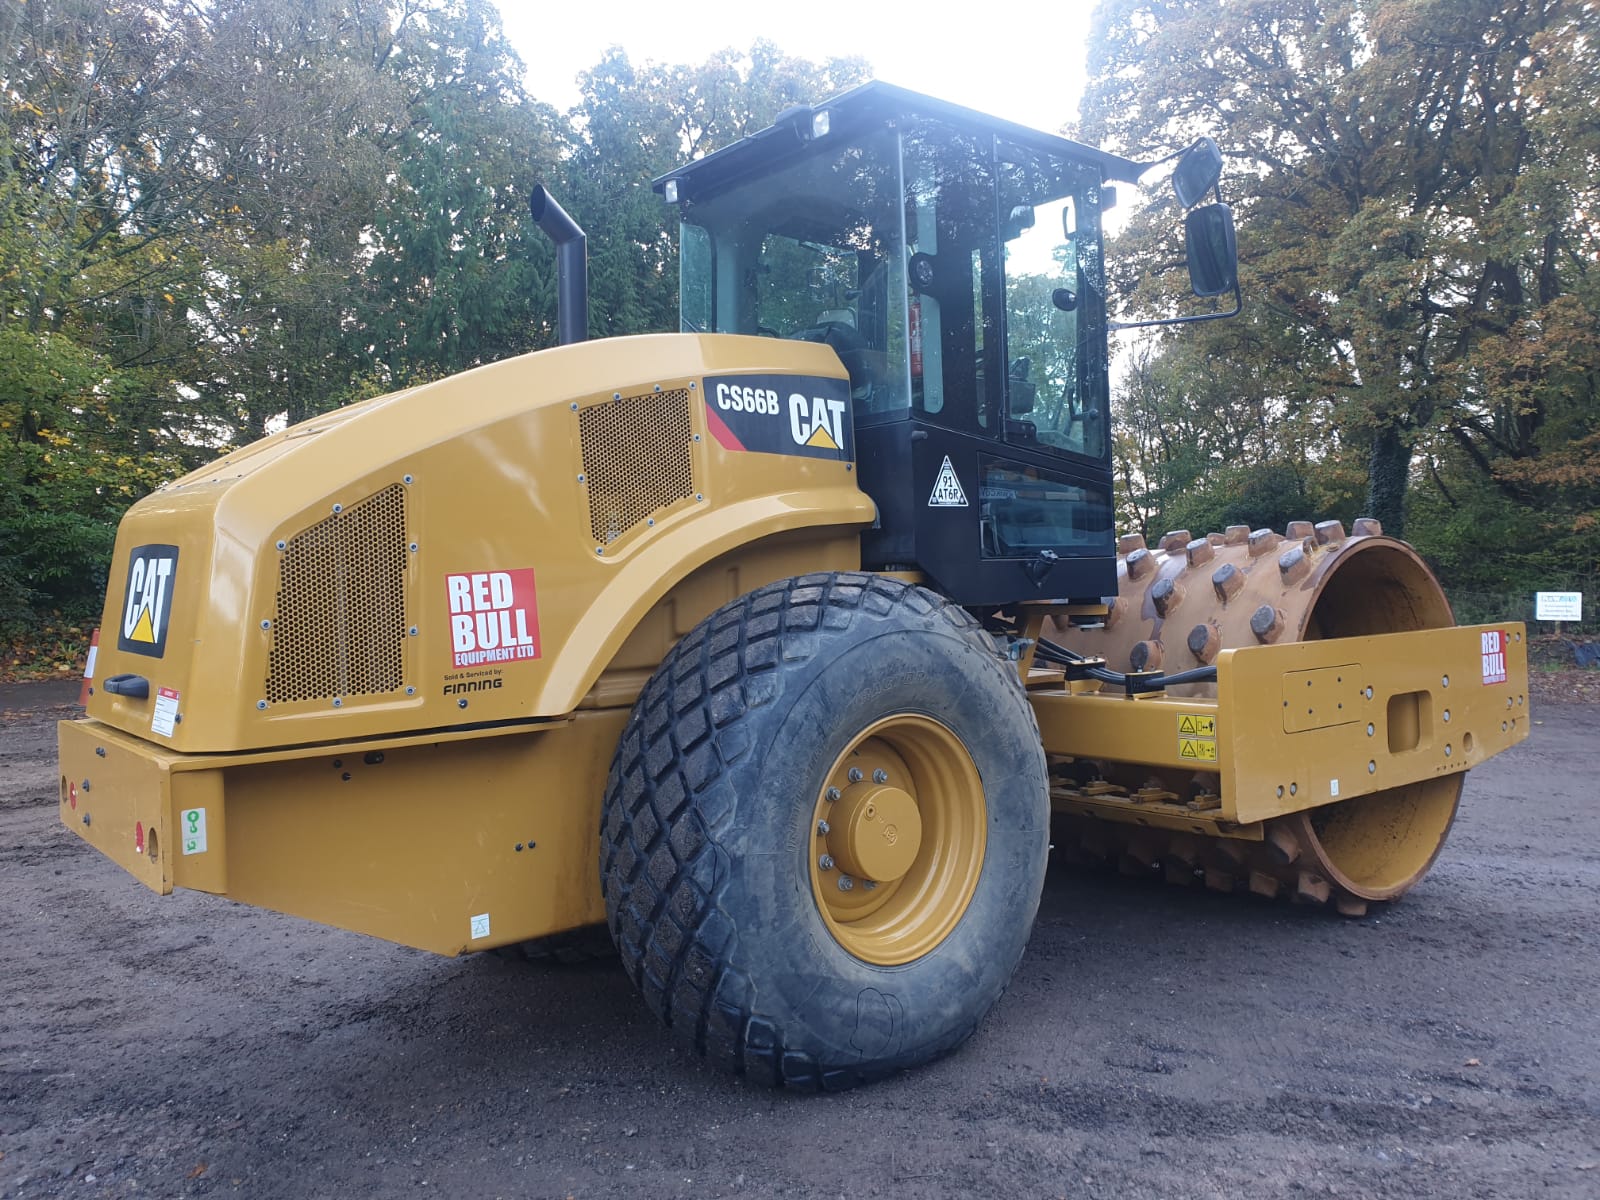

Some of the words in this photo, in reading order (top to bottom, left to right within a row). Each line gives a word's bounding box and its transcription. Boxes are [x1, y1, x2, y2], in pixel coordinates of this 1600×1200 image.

[716, 383, 780, 415] CS66B
[788, 393, 846, 450] CAT
[943, 476, 953, 487] 91
[124, 557, 173, 645] CAT
[447, 572, 514, 613] RED
[451, 609, 533, 652] BULL
[1481, 631, 1500, 654] RED
[455, 647, 515, 666] EQUIPMENT
[517, 645, 534, 658] LTD
[1482, 652, 1506, 677] BULL
[443, 678, 503, 695] FINNING
